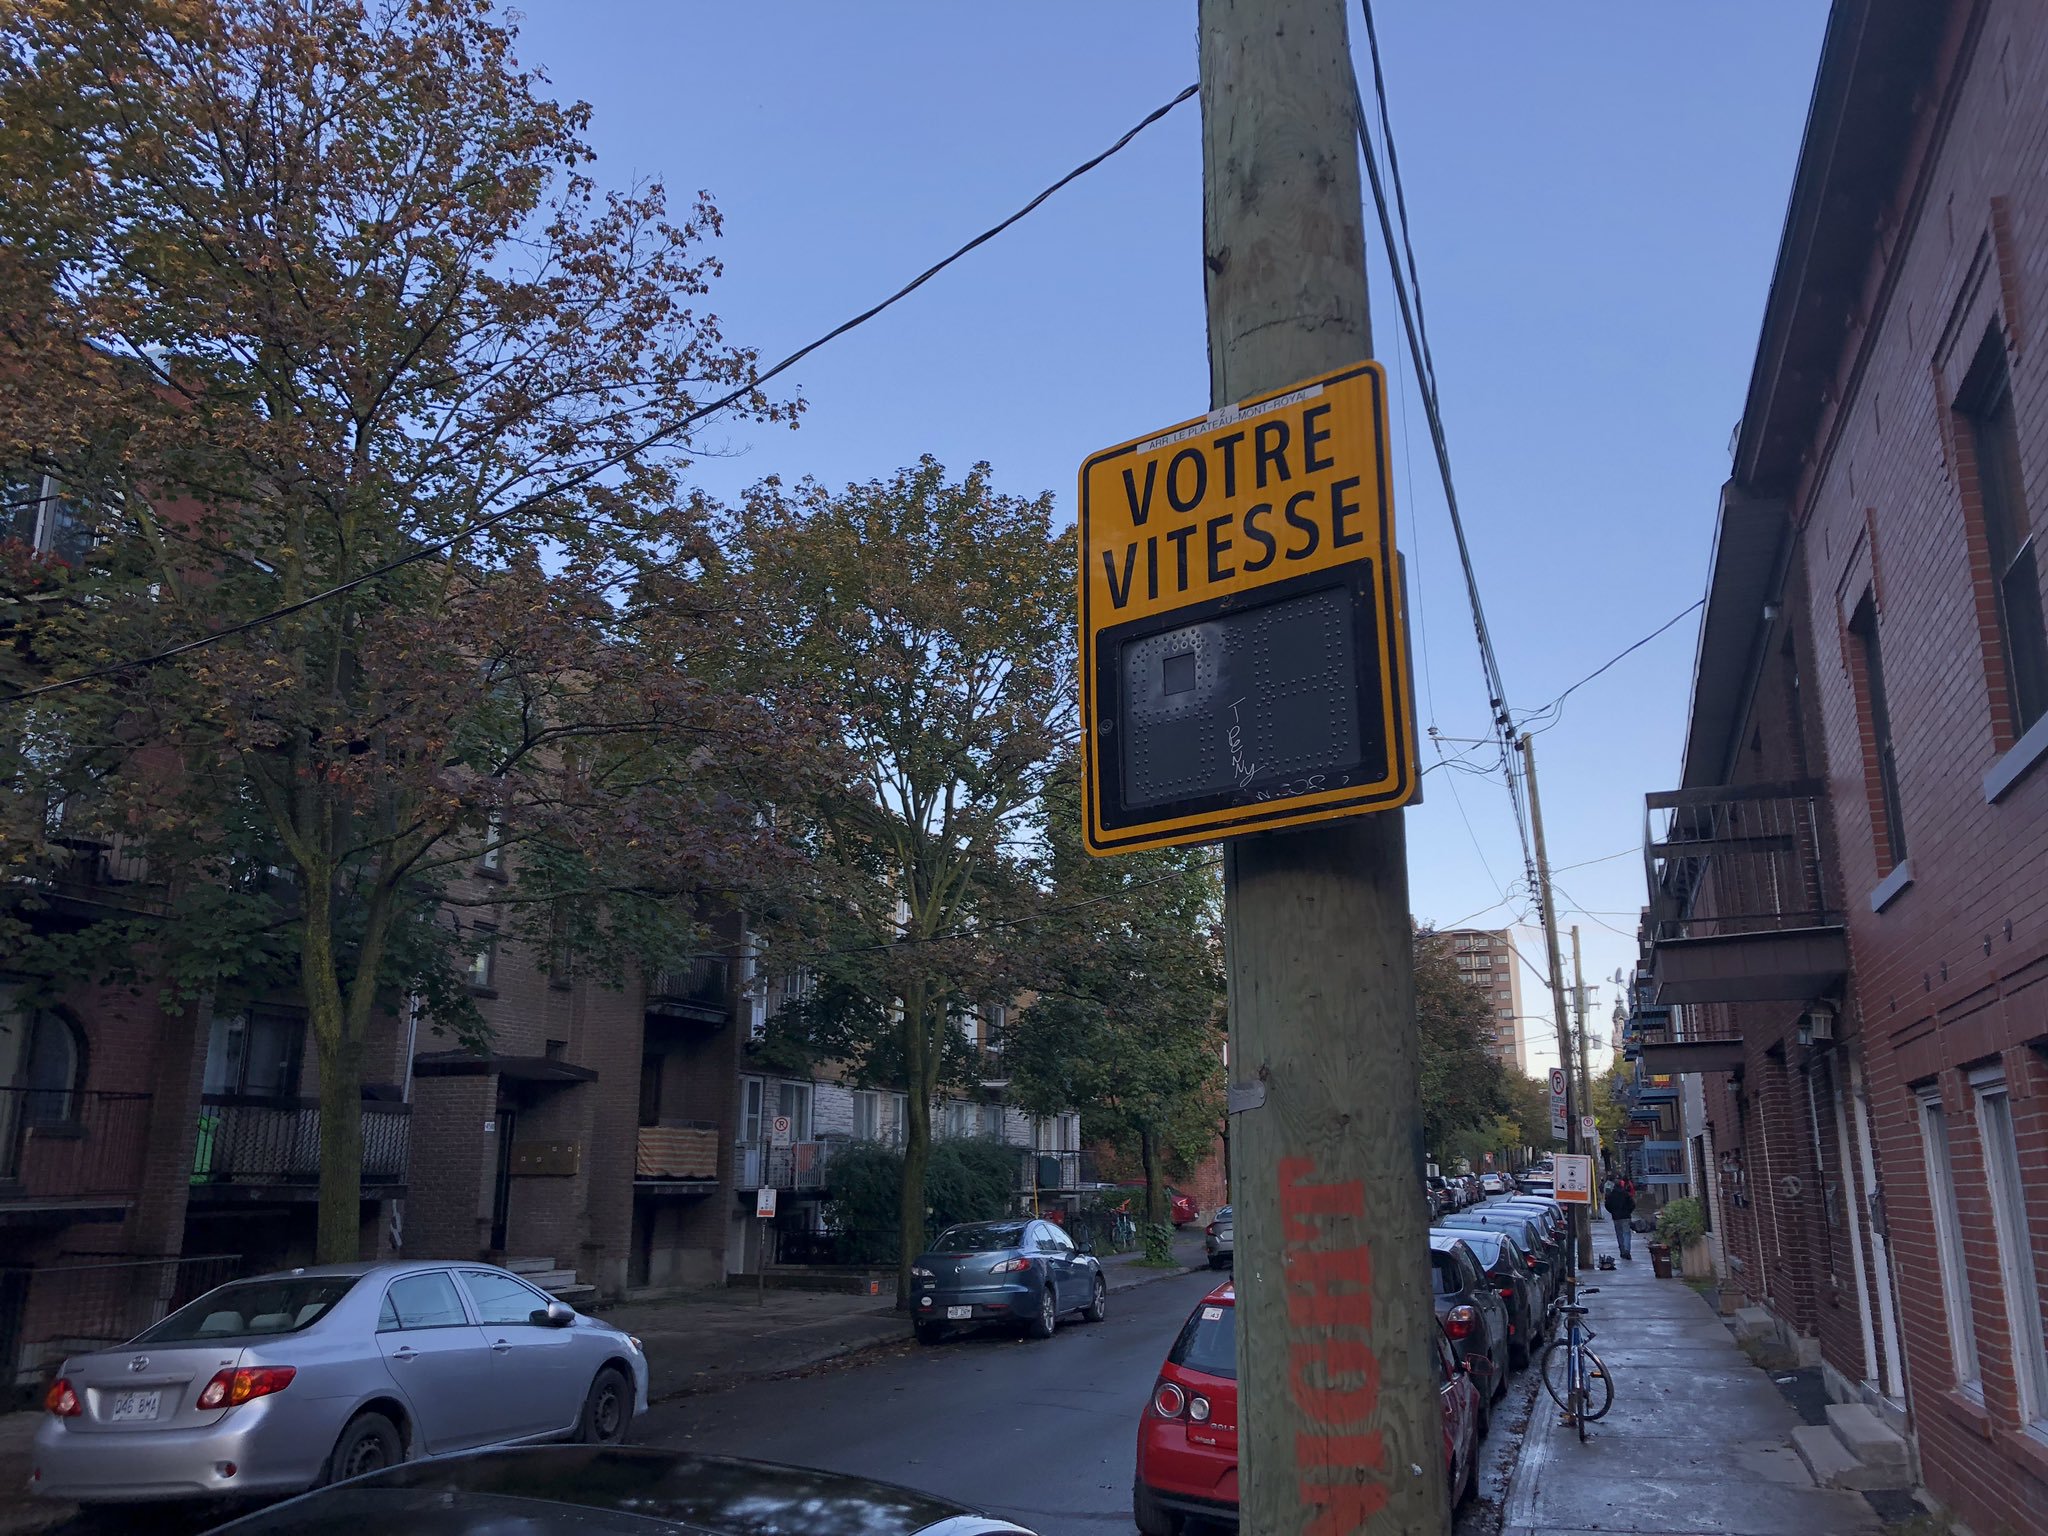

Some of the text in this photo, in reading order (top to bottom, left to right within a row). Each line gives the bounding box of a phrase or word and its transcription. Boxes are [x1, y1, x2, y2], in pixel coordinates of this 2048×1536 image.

[1174, 431, 1186, 442] LE
[1219, 408, 1226, 418] 2
[1122, 403, 1334, 526] VOTRE
[1102, 476, 1363, 609] VITESSE
